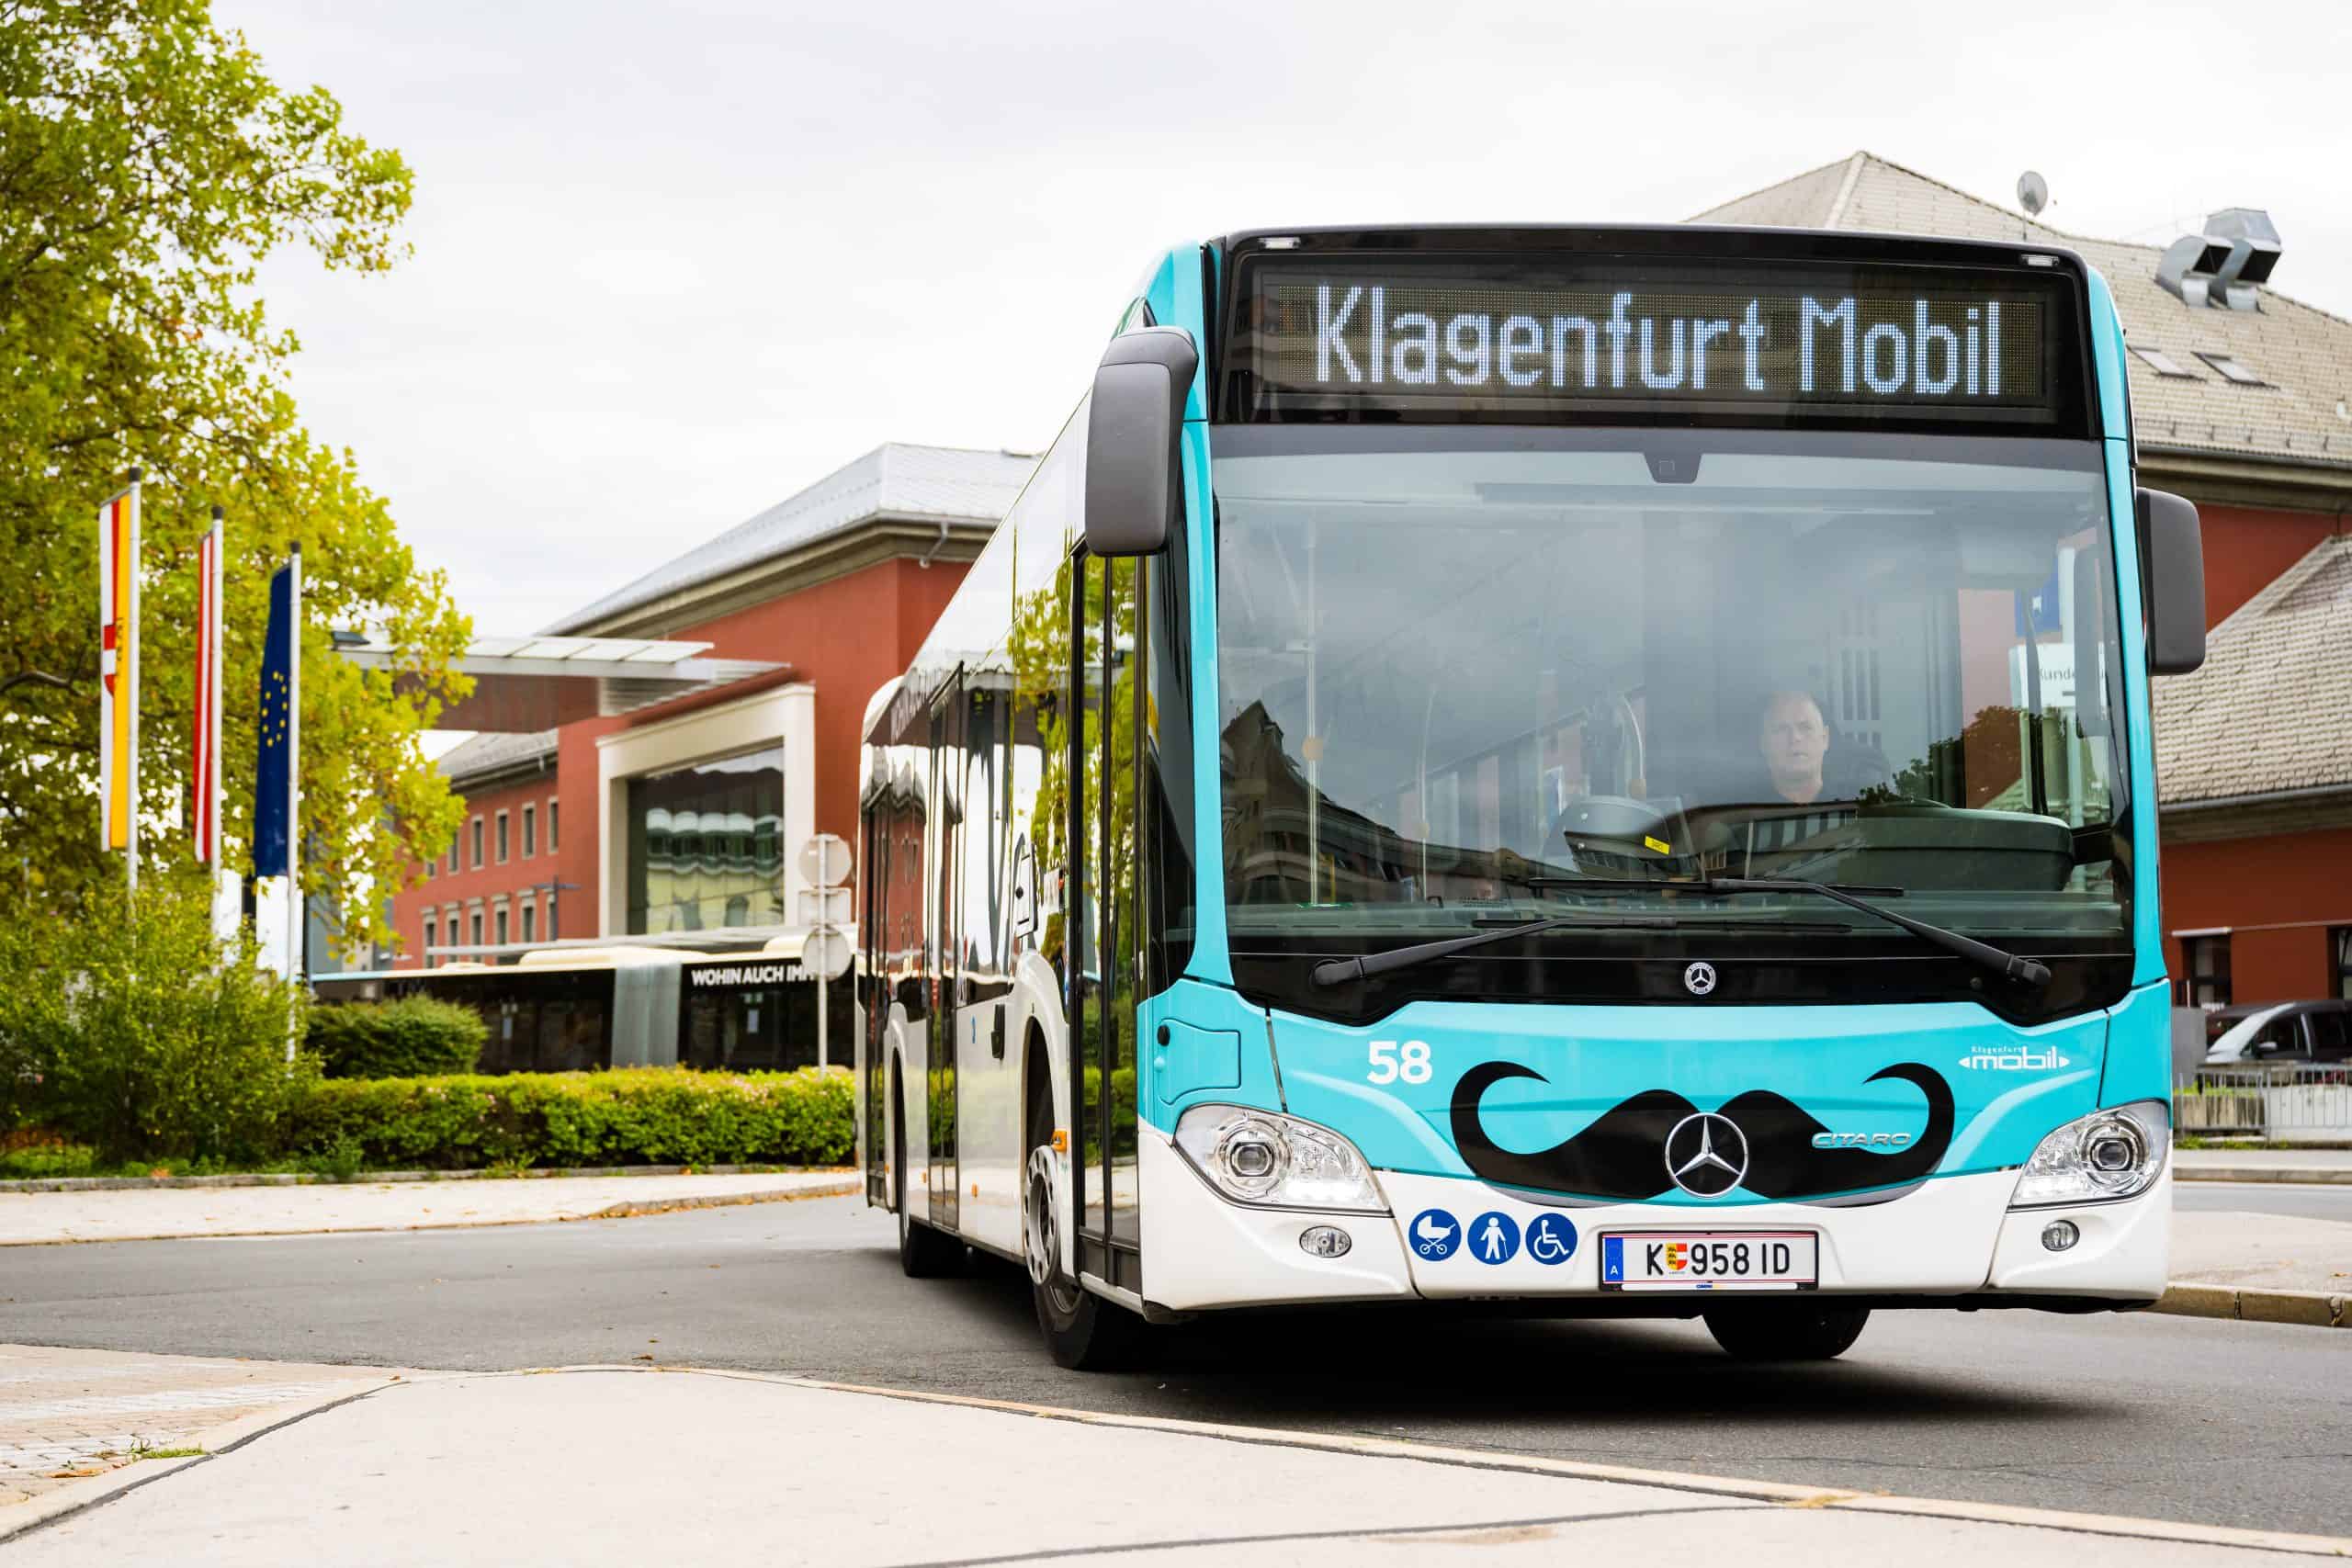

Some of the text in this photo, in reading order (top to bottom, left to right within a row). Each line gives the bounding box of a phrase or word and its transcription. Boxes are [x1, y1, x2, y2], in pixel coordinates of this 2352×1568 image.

[1316, 284, 2001, 397] Klagenfurt Mobil
[691, 964, 817, 986] WOHIN AUCH IMM
[1366, 1041, 1433, 1085] 58
[1971, 1045, 2057, 1070] mobil
[1811, 1132, 1912, 1148] CITARO
[1610, 1265, 1619, 1275] A
[1646, 1243, 1791, 1276] K 958 ID
